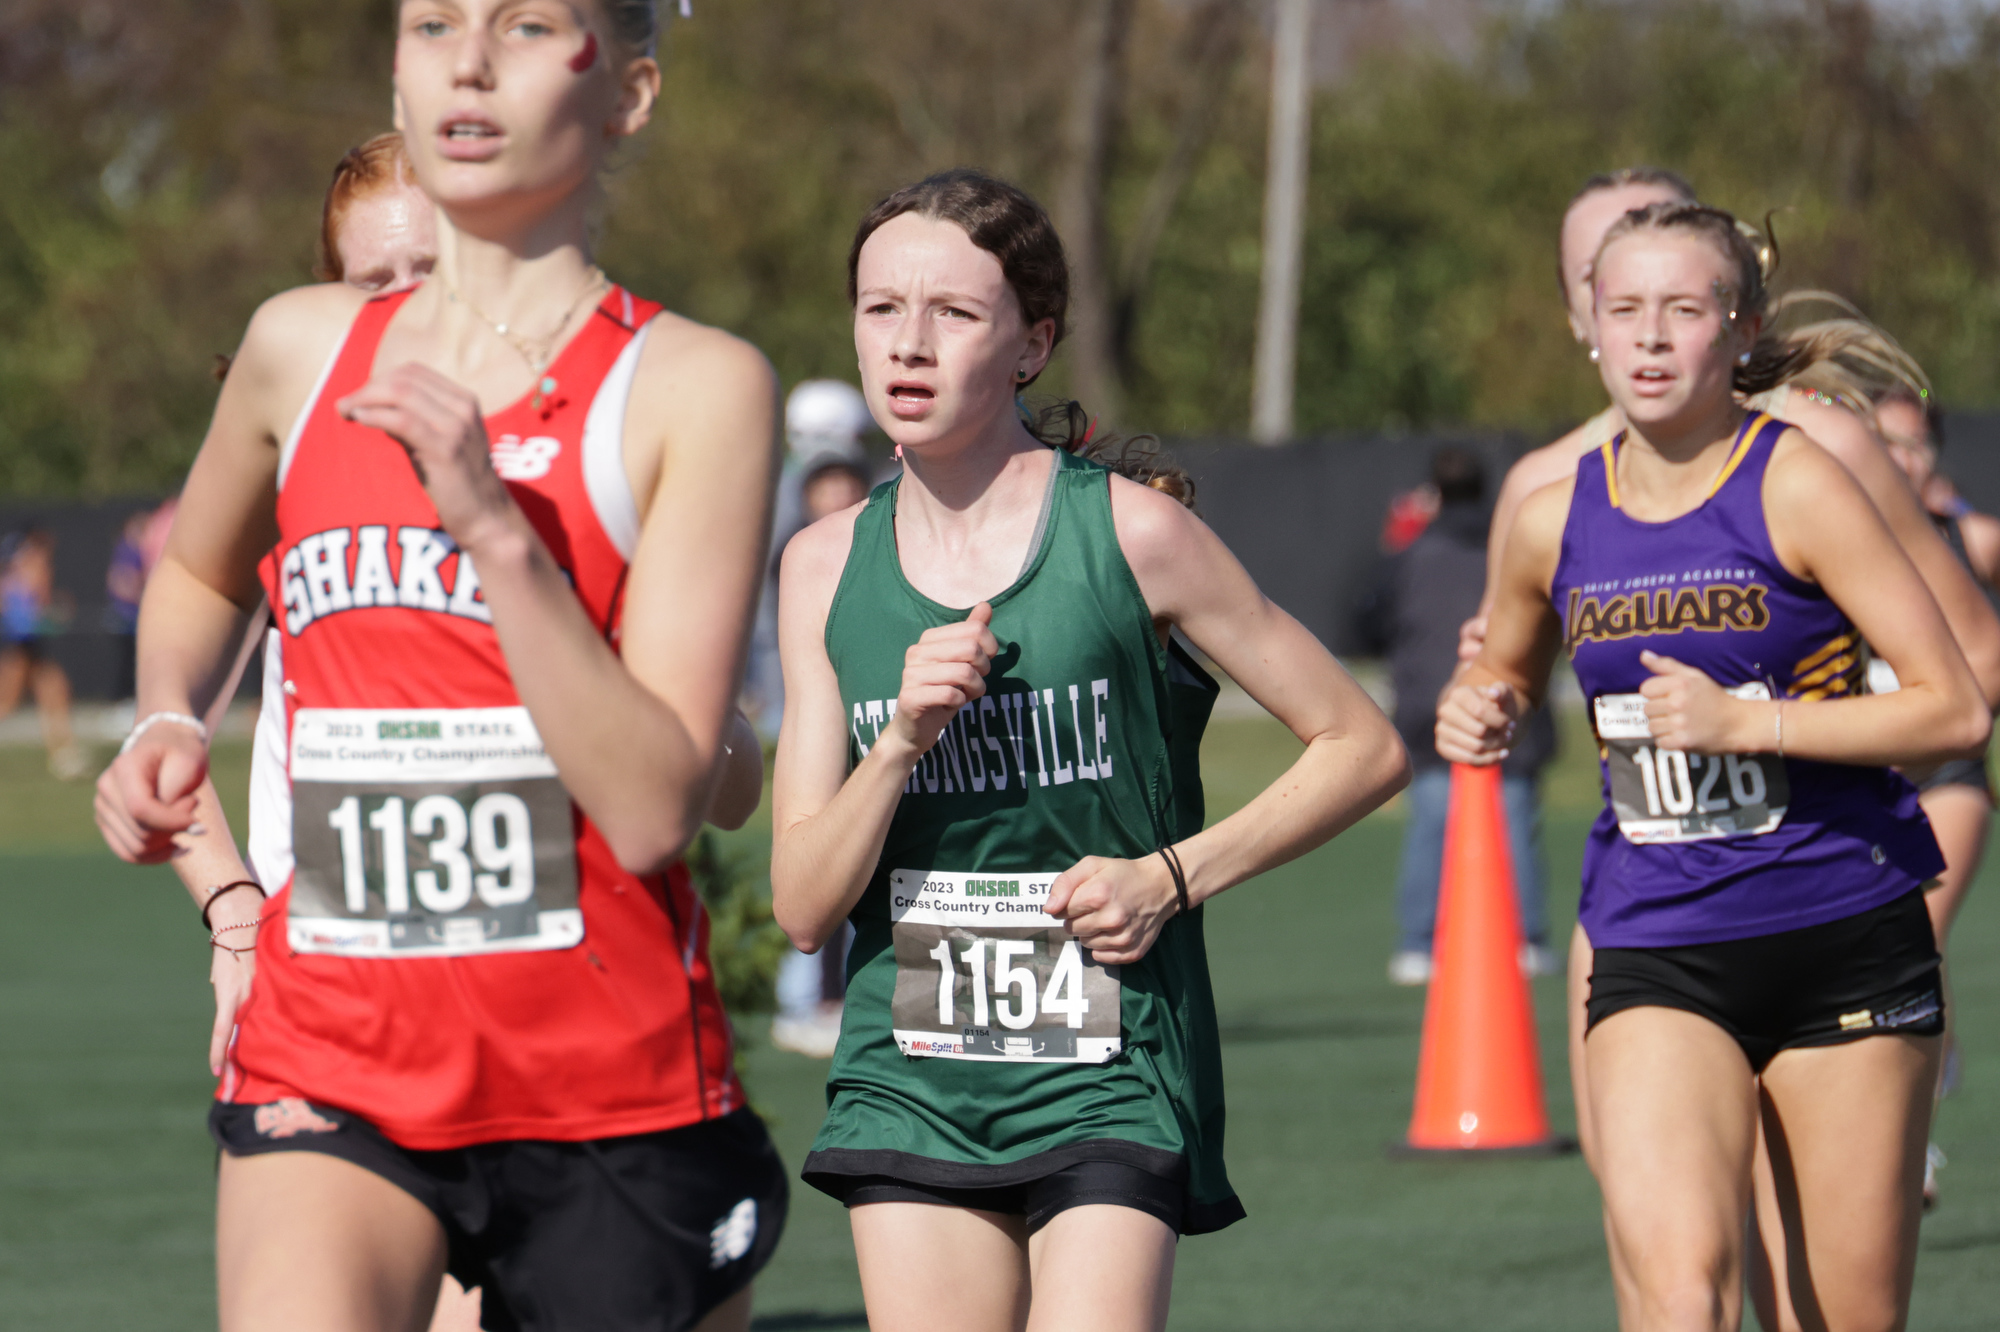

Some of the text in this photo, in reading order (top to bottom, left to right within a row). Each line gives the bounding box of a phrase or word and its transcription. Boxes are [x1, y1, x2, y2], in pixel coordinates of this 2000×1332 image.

[1583, 568, 1756, 594] SAINT JOSEPH ACADEMY
[1564, 583, 1770, 661] JAGUARS
[454, 723, 516, 736] STATE
[1632, 745, 1767, 816] 1026
[328, 793, 535, 913] 1139
[923, 880, 1054, 897] 2023 OHSAA ST
[894, 896, 931, 909] Cross
[934, 900, 990, 915] Country
[929, 939, 1089, 1030] 1154
[964, 1028, 990, 1037] 01154
[911, 1041, 953, 1053] MileSplit
